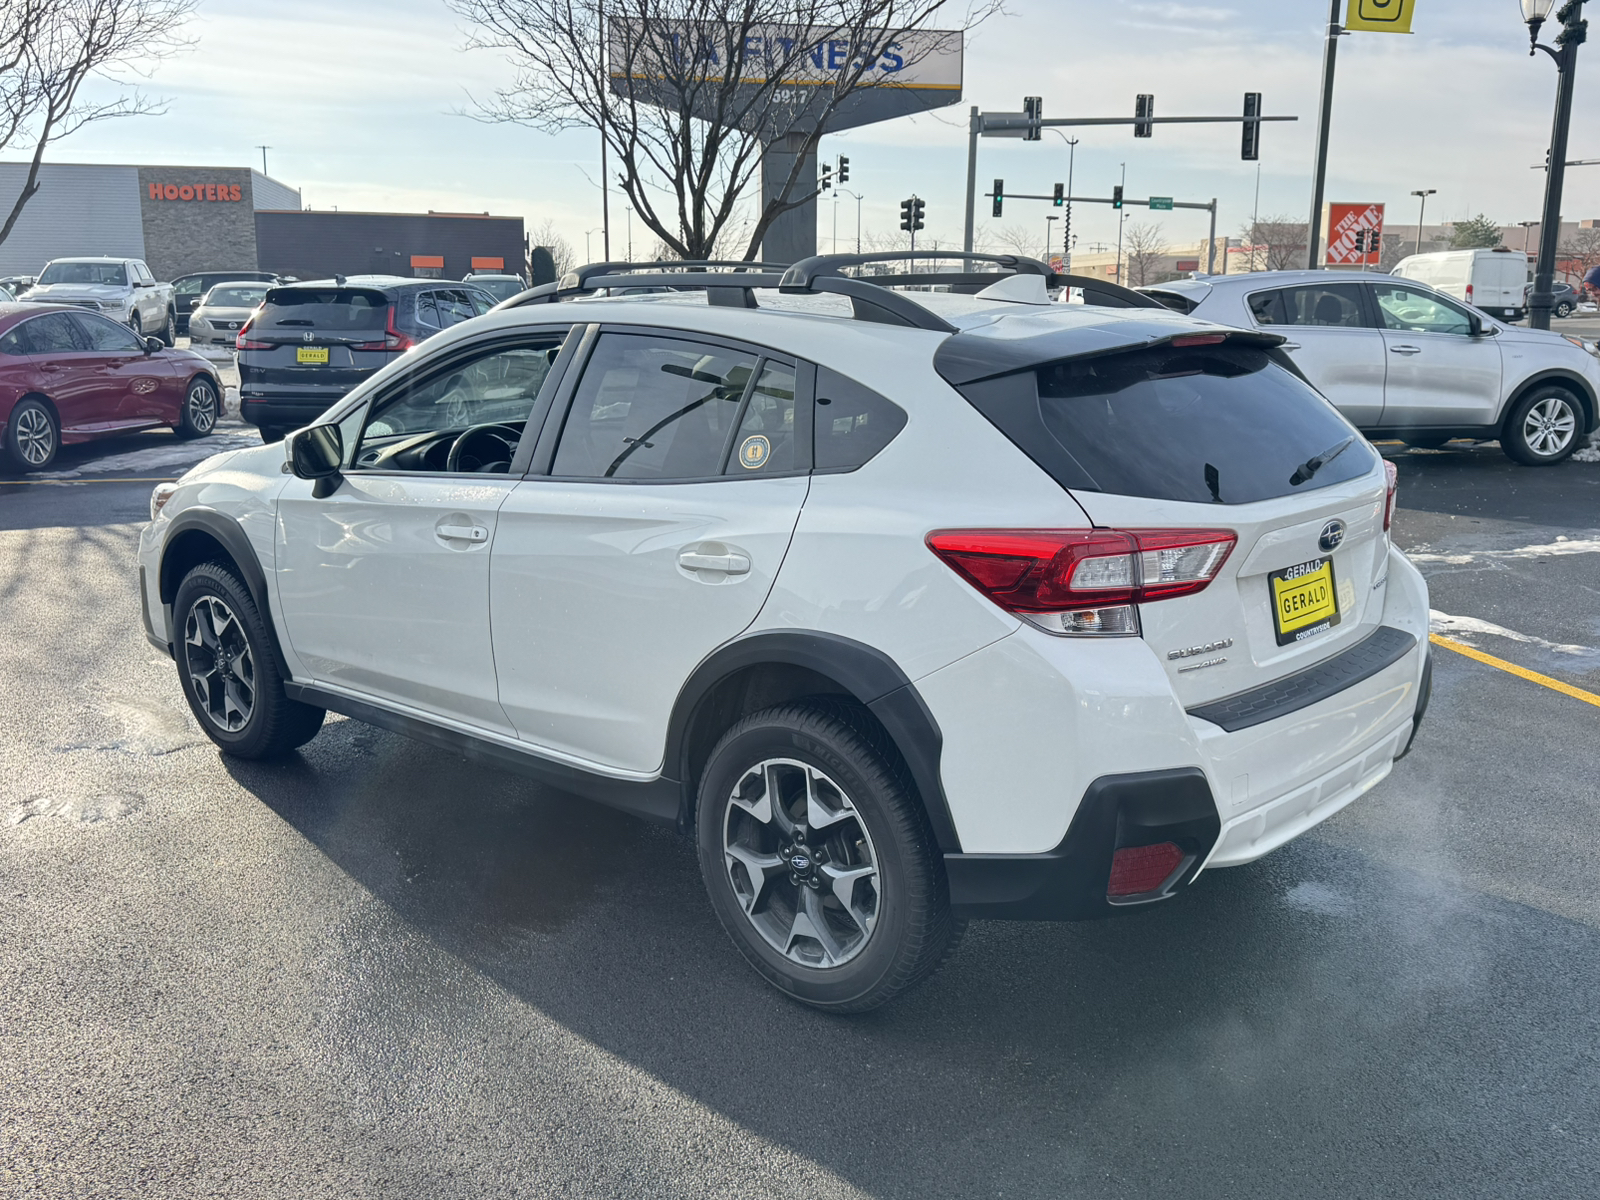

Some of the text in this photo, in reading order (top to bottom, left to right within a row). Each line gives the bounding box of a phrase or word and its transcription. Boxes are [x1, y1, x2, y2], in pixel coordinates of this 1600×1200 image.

[148, 182, 242, 202] HOOTERS
[1327, 204, 1383, 263] HOME
[1334, 210, 1358, 234] THE
[1283, 585, 1326, 614] GERALD
[1295, 621, 1331, 641] COUNTRYSIDE
[1167, 637, 1233, 661] SUBARU
